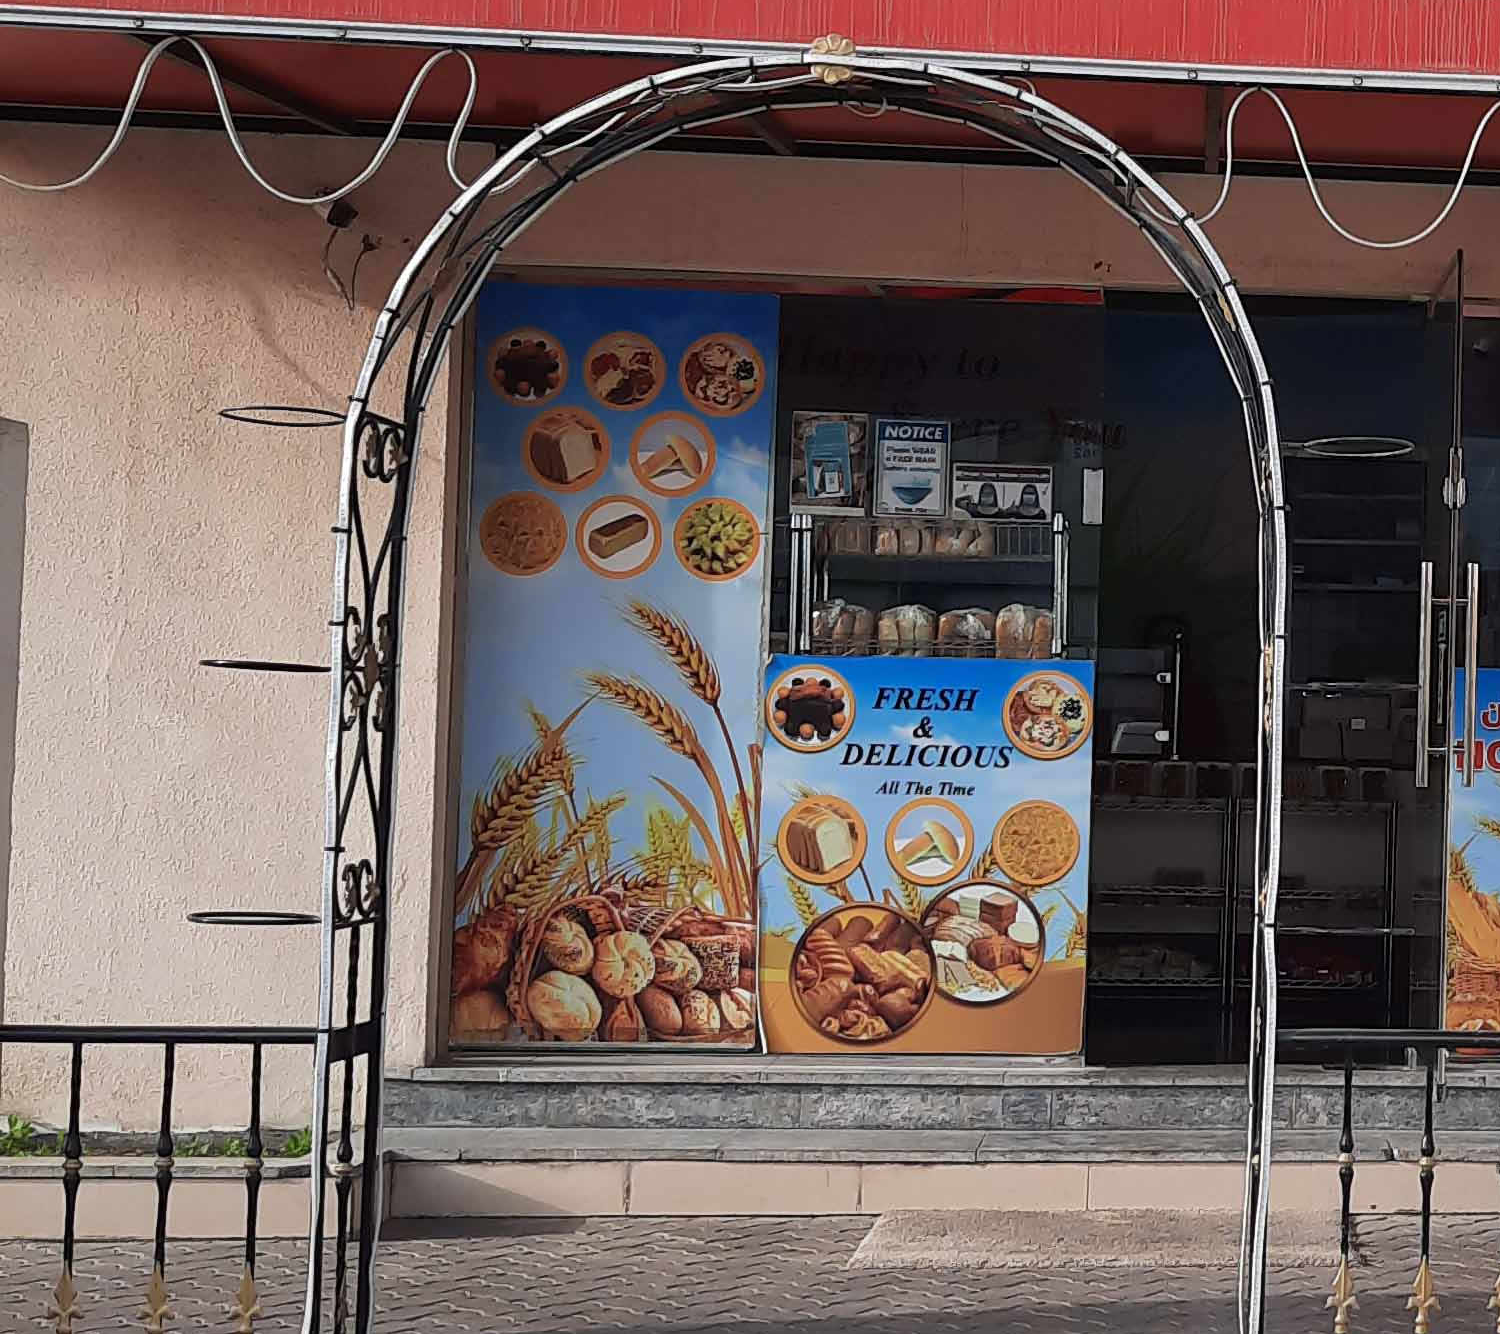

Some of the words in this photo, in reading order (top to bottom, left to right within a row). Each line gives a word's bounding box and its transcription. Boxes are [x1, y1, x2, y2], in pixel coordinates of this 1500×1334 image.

[884, 425, 943, 440] NOTICE
[872, 687, 980, 711] FRESH
[912, 716, 933, 738] &
[840, 743, 1014, 768] DELICIOUS
[876, 780, 900, 795] All
[904, 781, 932, 796] The
[938, 782, 975, 796] Time
